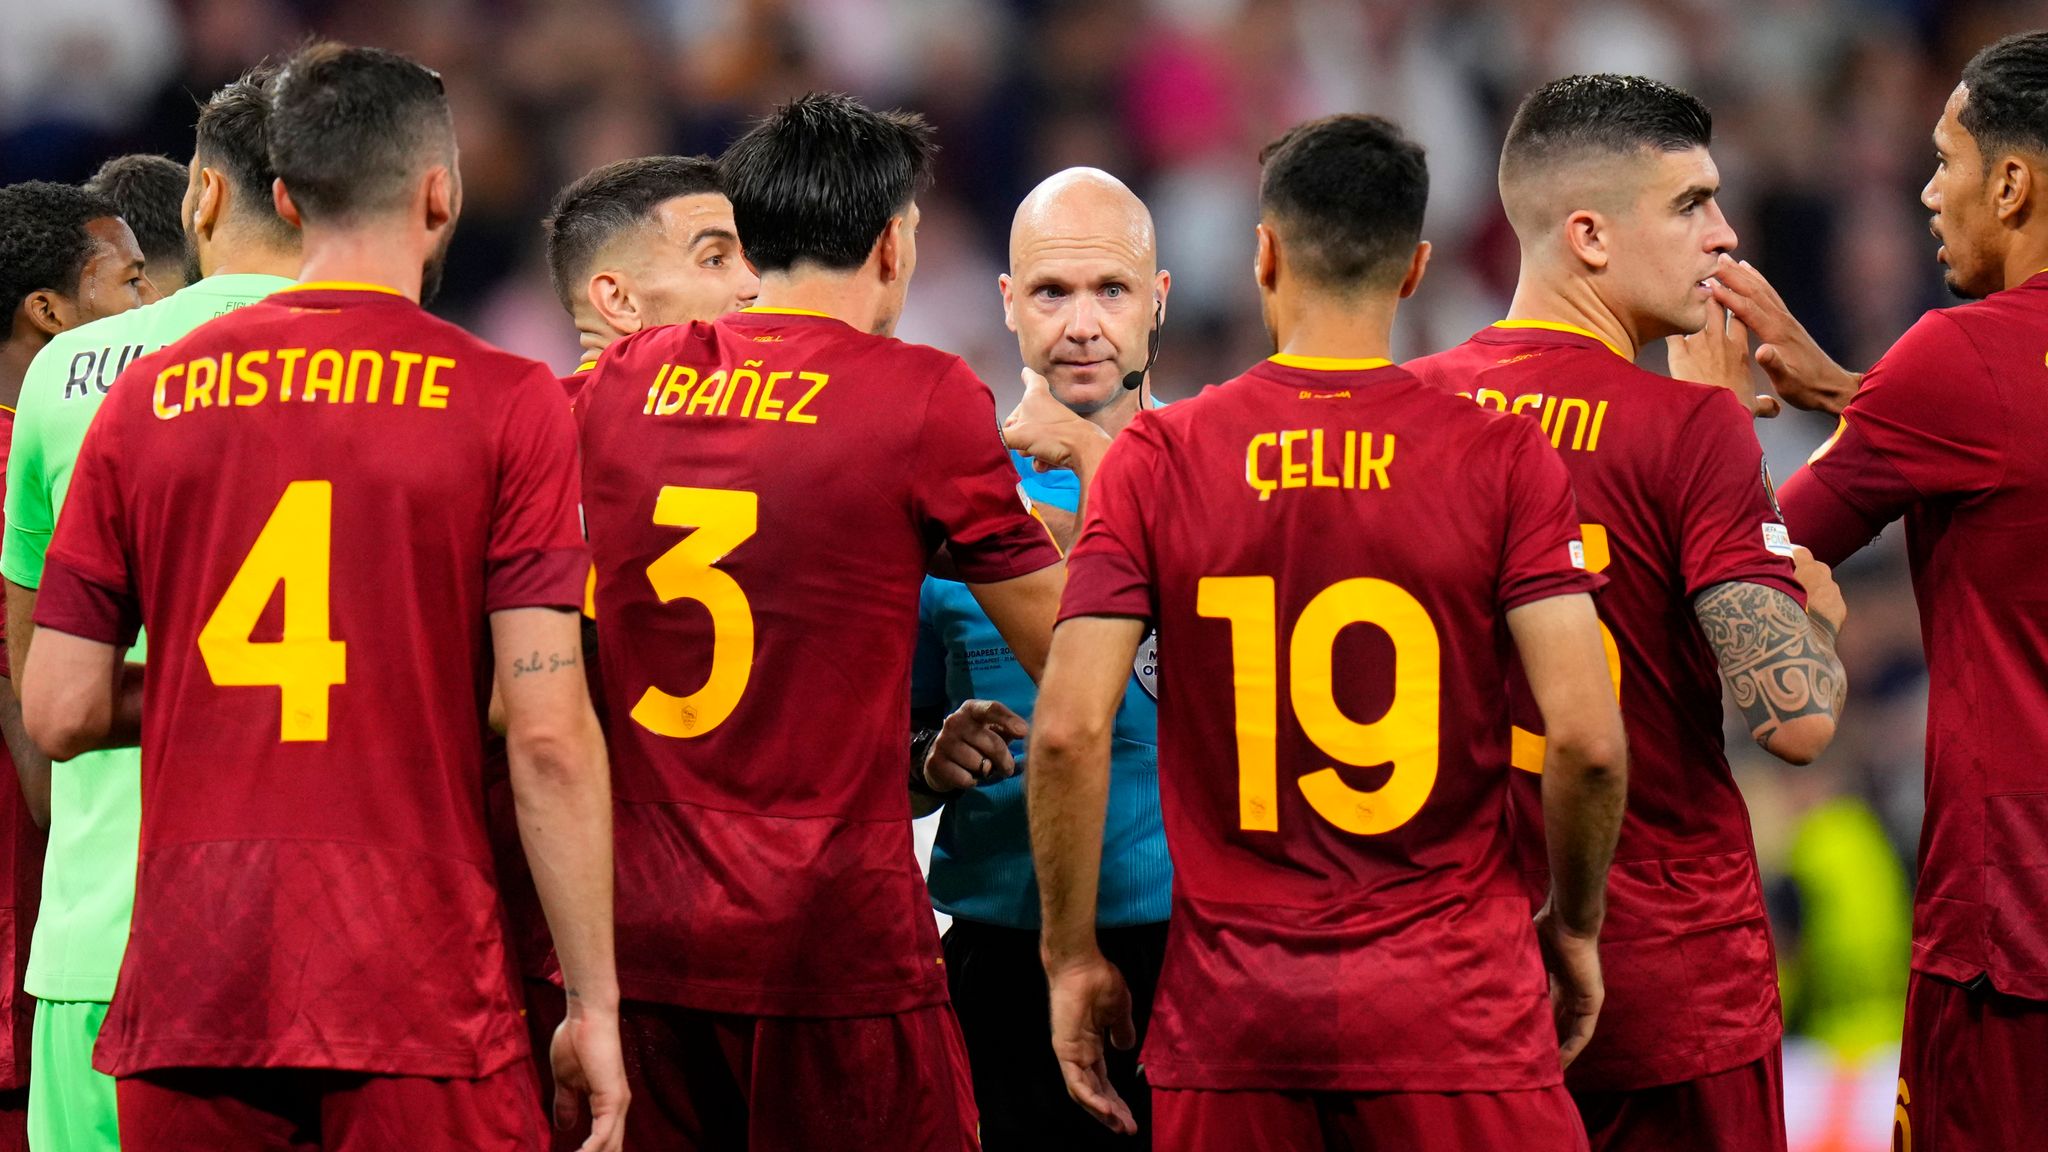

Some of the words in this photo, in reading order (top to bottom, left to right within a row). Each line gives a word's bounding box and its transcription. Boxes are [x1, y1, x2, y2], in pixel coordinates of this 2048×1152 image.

[152, 348, 456, 420] CRISTANTE
[643, 360, 830, 424] IBAÑEZ
[1246, 428, 1396, 502] ÇELIK
[198, 480, 346, 741] 4
[630, 485, 758, 739] 3
[1197, 576, 1440, 835] 19
